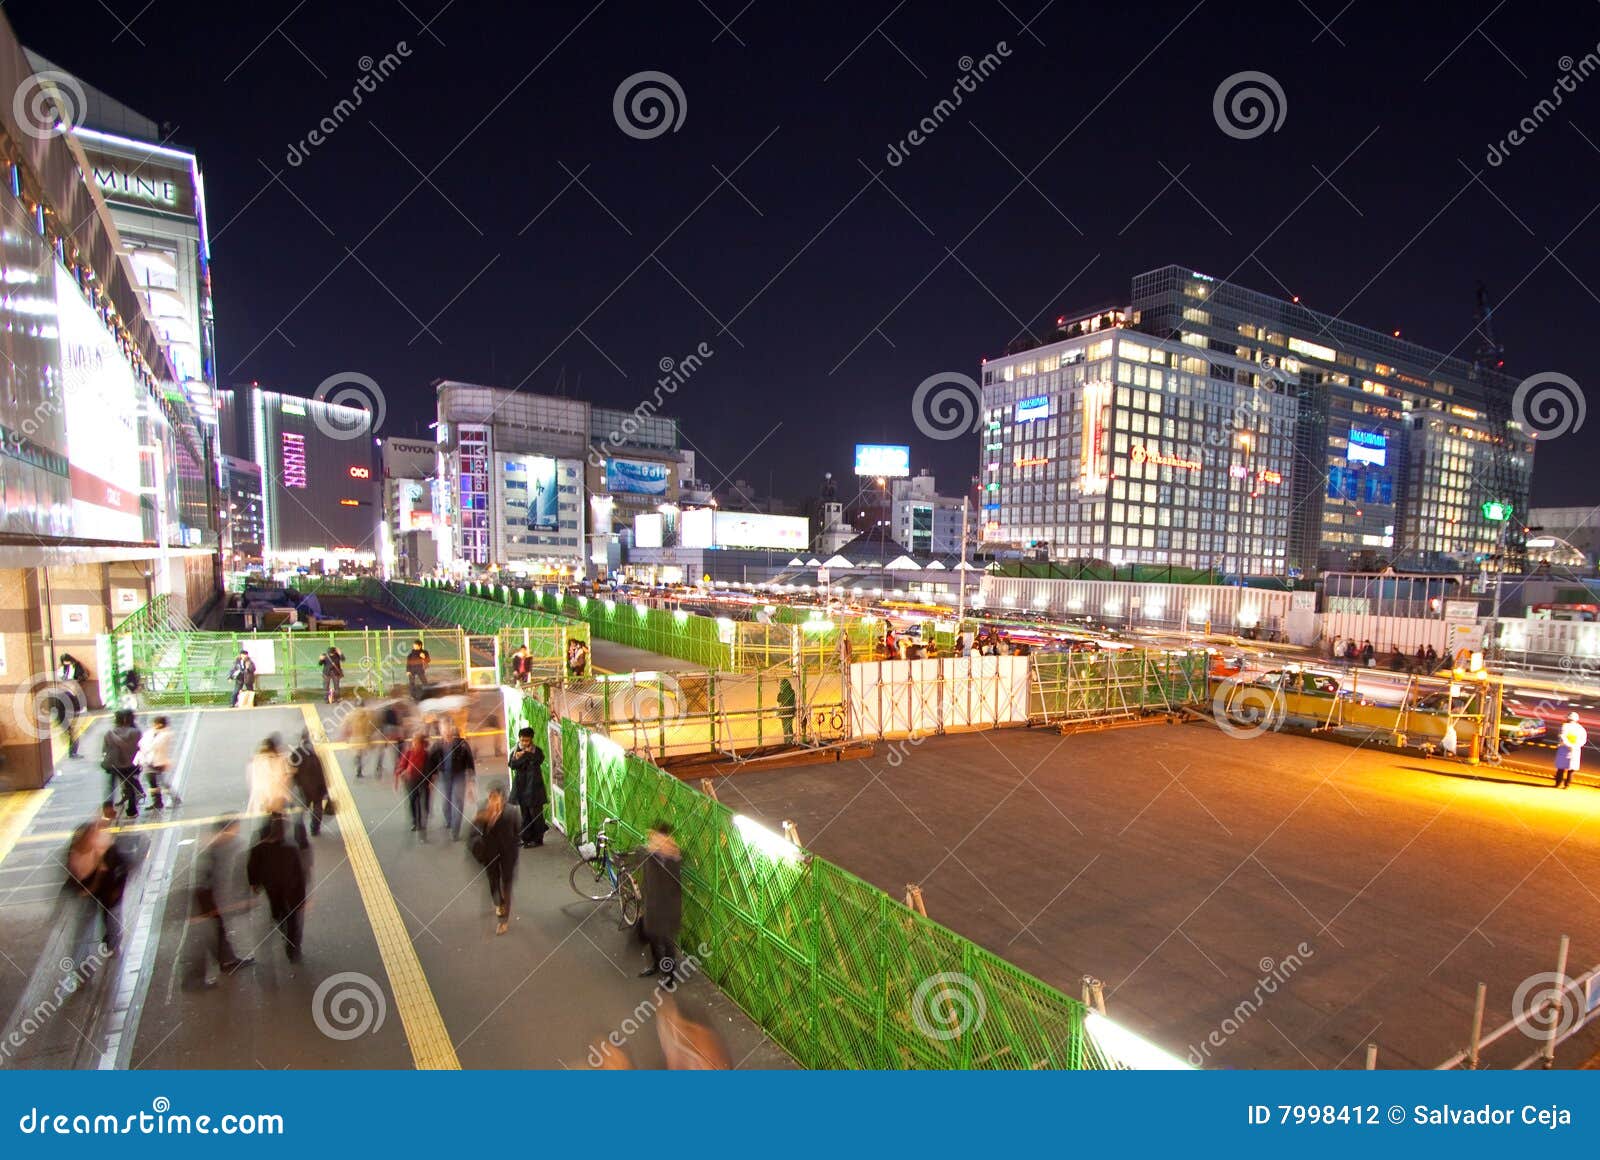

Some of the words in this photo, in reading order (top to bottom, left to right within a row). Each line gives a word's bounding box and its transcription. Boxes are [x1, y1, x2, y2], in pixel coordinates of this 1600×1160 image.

[79, 166, 176, 205] MINE
[392, 443, 435, 455] TOYOTA
[475, 446, 486, 491] Victoria
